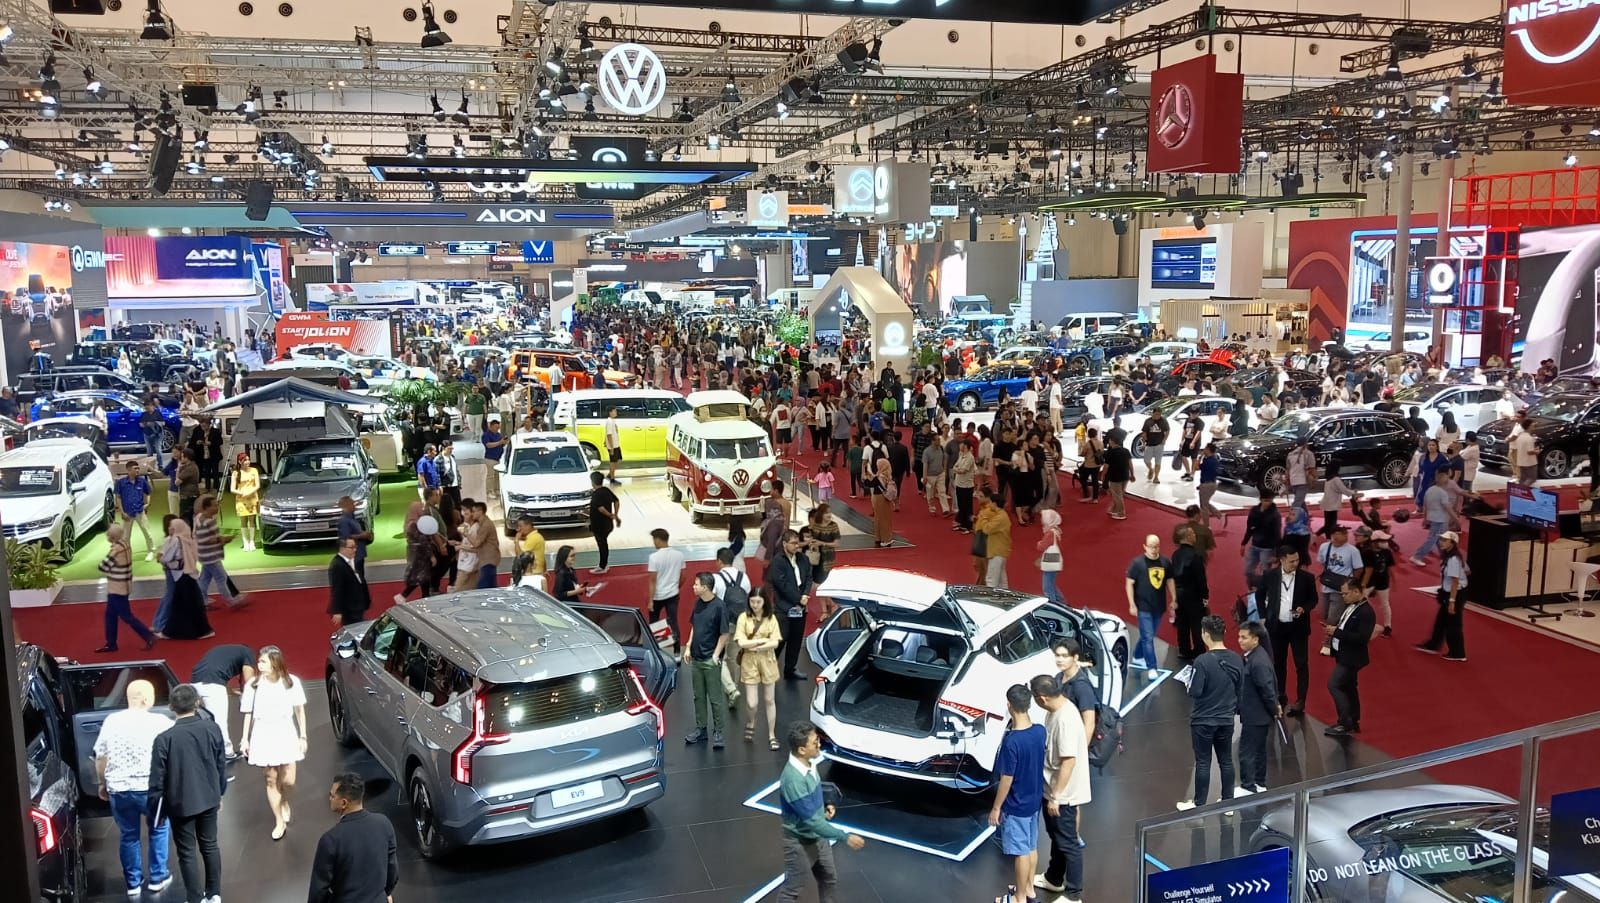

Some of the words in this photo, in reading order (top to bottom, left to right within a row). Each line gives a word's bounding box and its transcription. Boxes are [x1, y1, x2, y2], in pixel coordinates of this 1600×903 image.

[476, 208, 545, 222] AION
[84, 250, 106, 268] GWM
[185, 249, 237, 260] AION
[303, 326, 351, 340] JOLION
[571, 789, 585, 799] EV9
[1309, 868, 1328, 883] DO
[1334, 862, 1360, 880] NOT
[1363, 856, 1398, 875] LEAN
[1399, 853, 1421, 869] ON
[1421, 847, 1452, 866] THE
[1454, 840, 1502, 861] GLASS
[1163, 889, 1191, 899] Challenge
[1190, 883, 1215, 895] Yourself
